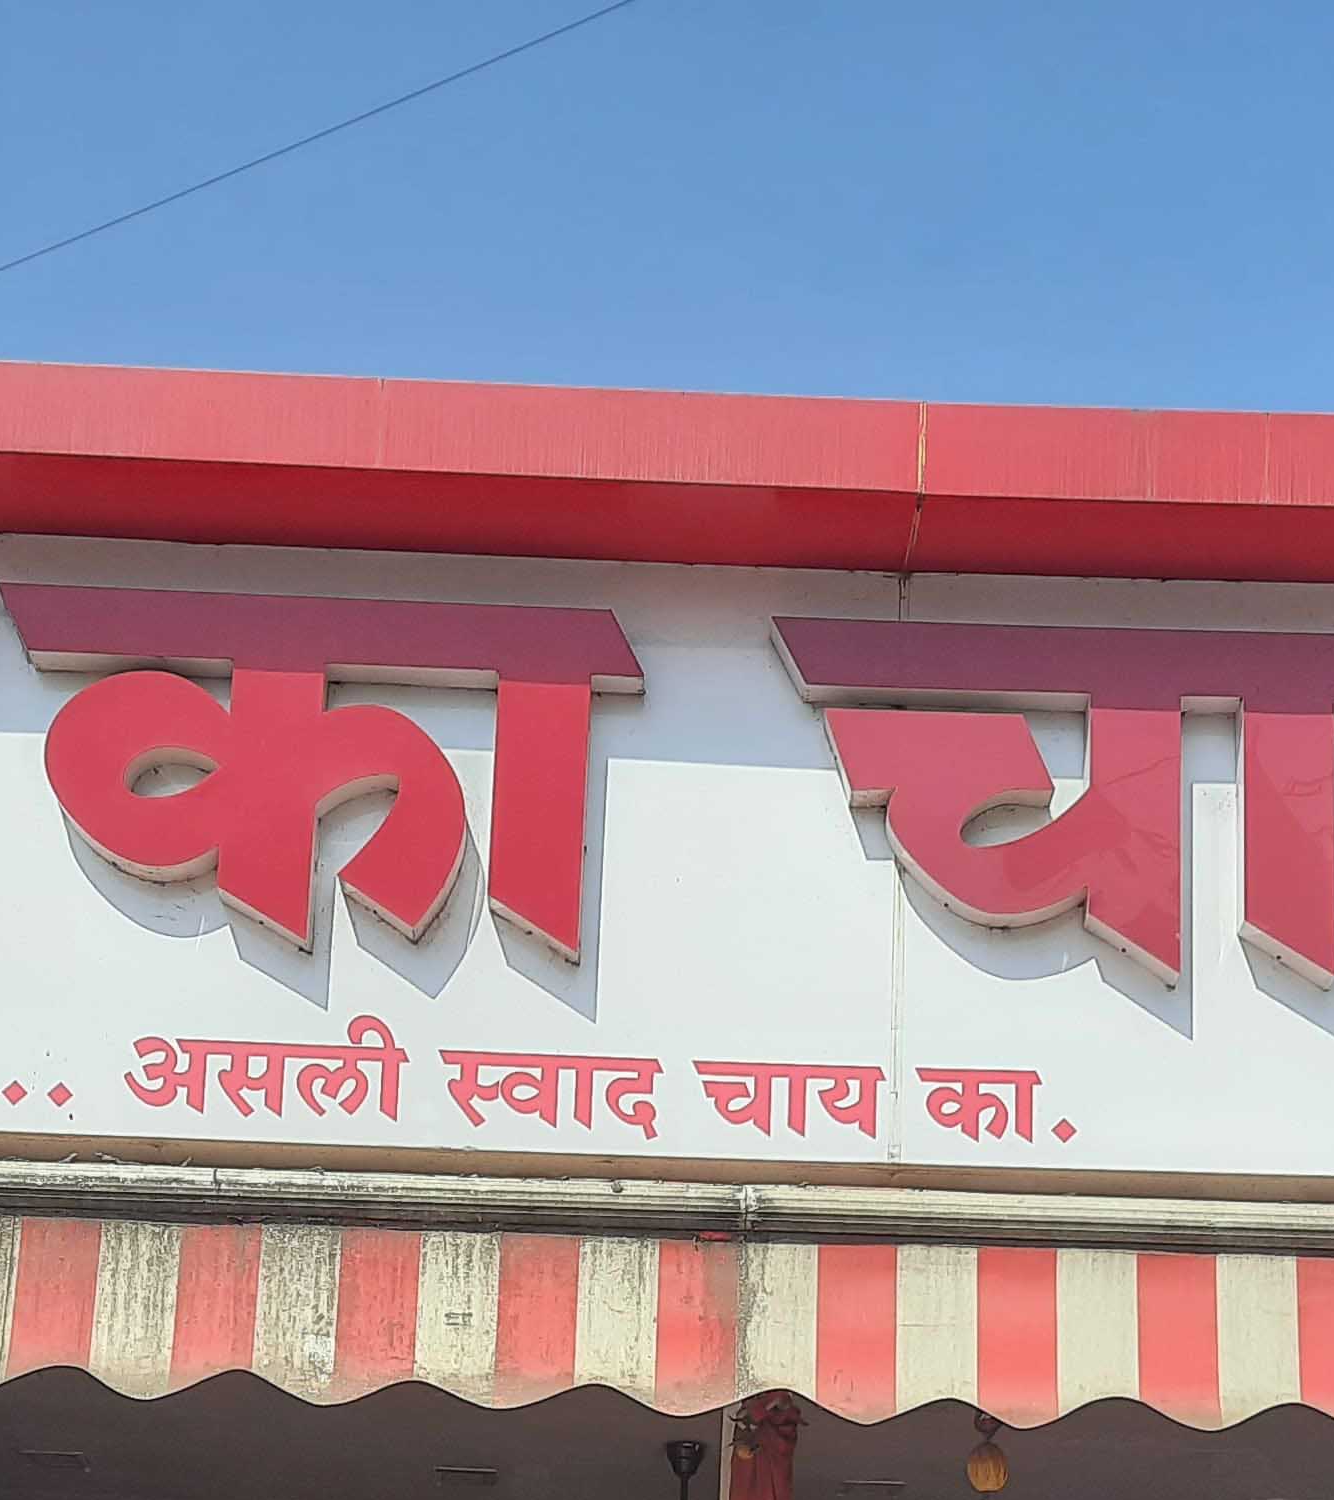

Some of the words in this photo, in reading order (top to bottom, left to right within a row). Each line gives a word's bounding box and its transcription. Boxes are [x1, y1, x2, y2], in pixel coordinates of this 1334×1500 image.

[123, 1014, 411, 1123] असली
[438, 1049, 665, 1140] स्वाद
[691, 1059, 887, 1140] चाय
